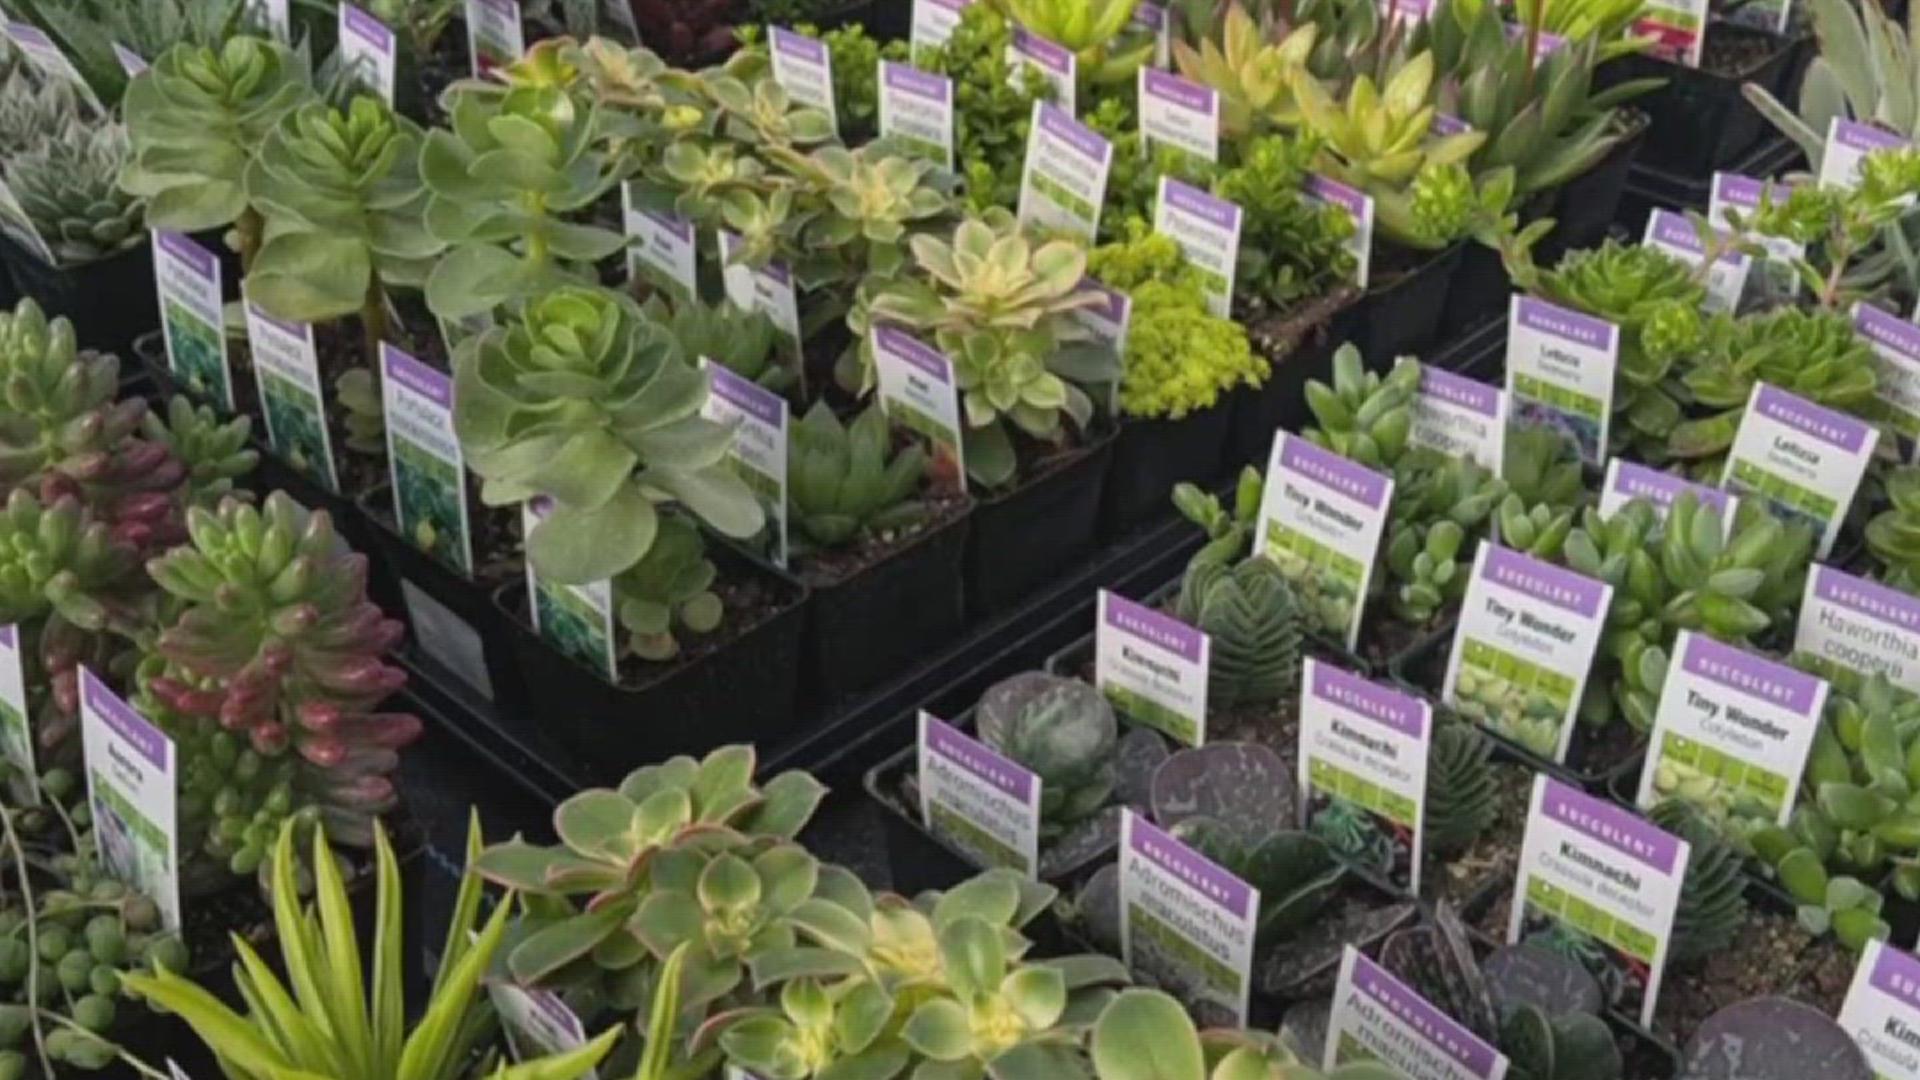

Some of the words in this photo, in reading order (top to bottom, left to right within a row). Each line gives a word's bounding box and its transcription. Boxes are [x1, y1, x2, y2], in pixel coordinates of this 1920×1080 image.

[1497, 565, 1583, 604] SUCCULENT
[1486, 596, 1515, 623] Tiny
[1519, 611, 1576, 643] Wonder
[1820, 606, 1919, 660] Haworthia
[1698, 658, 1795, 701] SUCCULENT
[1687, 689, 1719, 718] Tiny
[1725, 705, 1790, 741] Wonder
[1558, 803, 1656, 857] SUCCULENT
